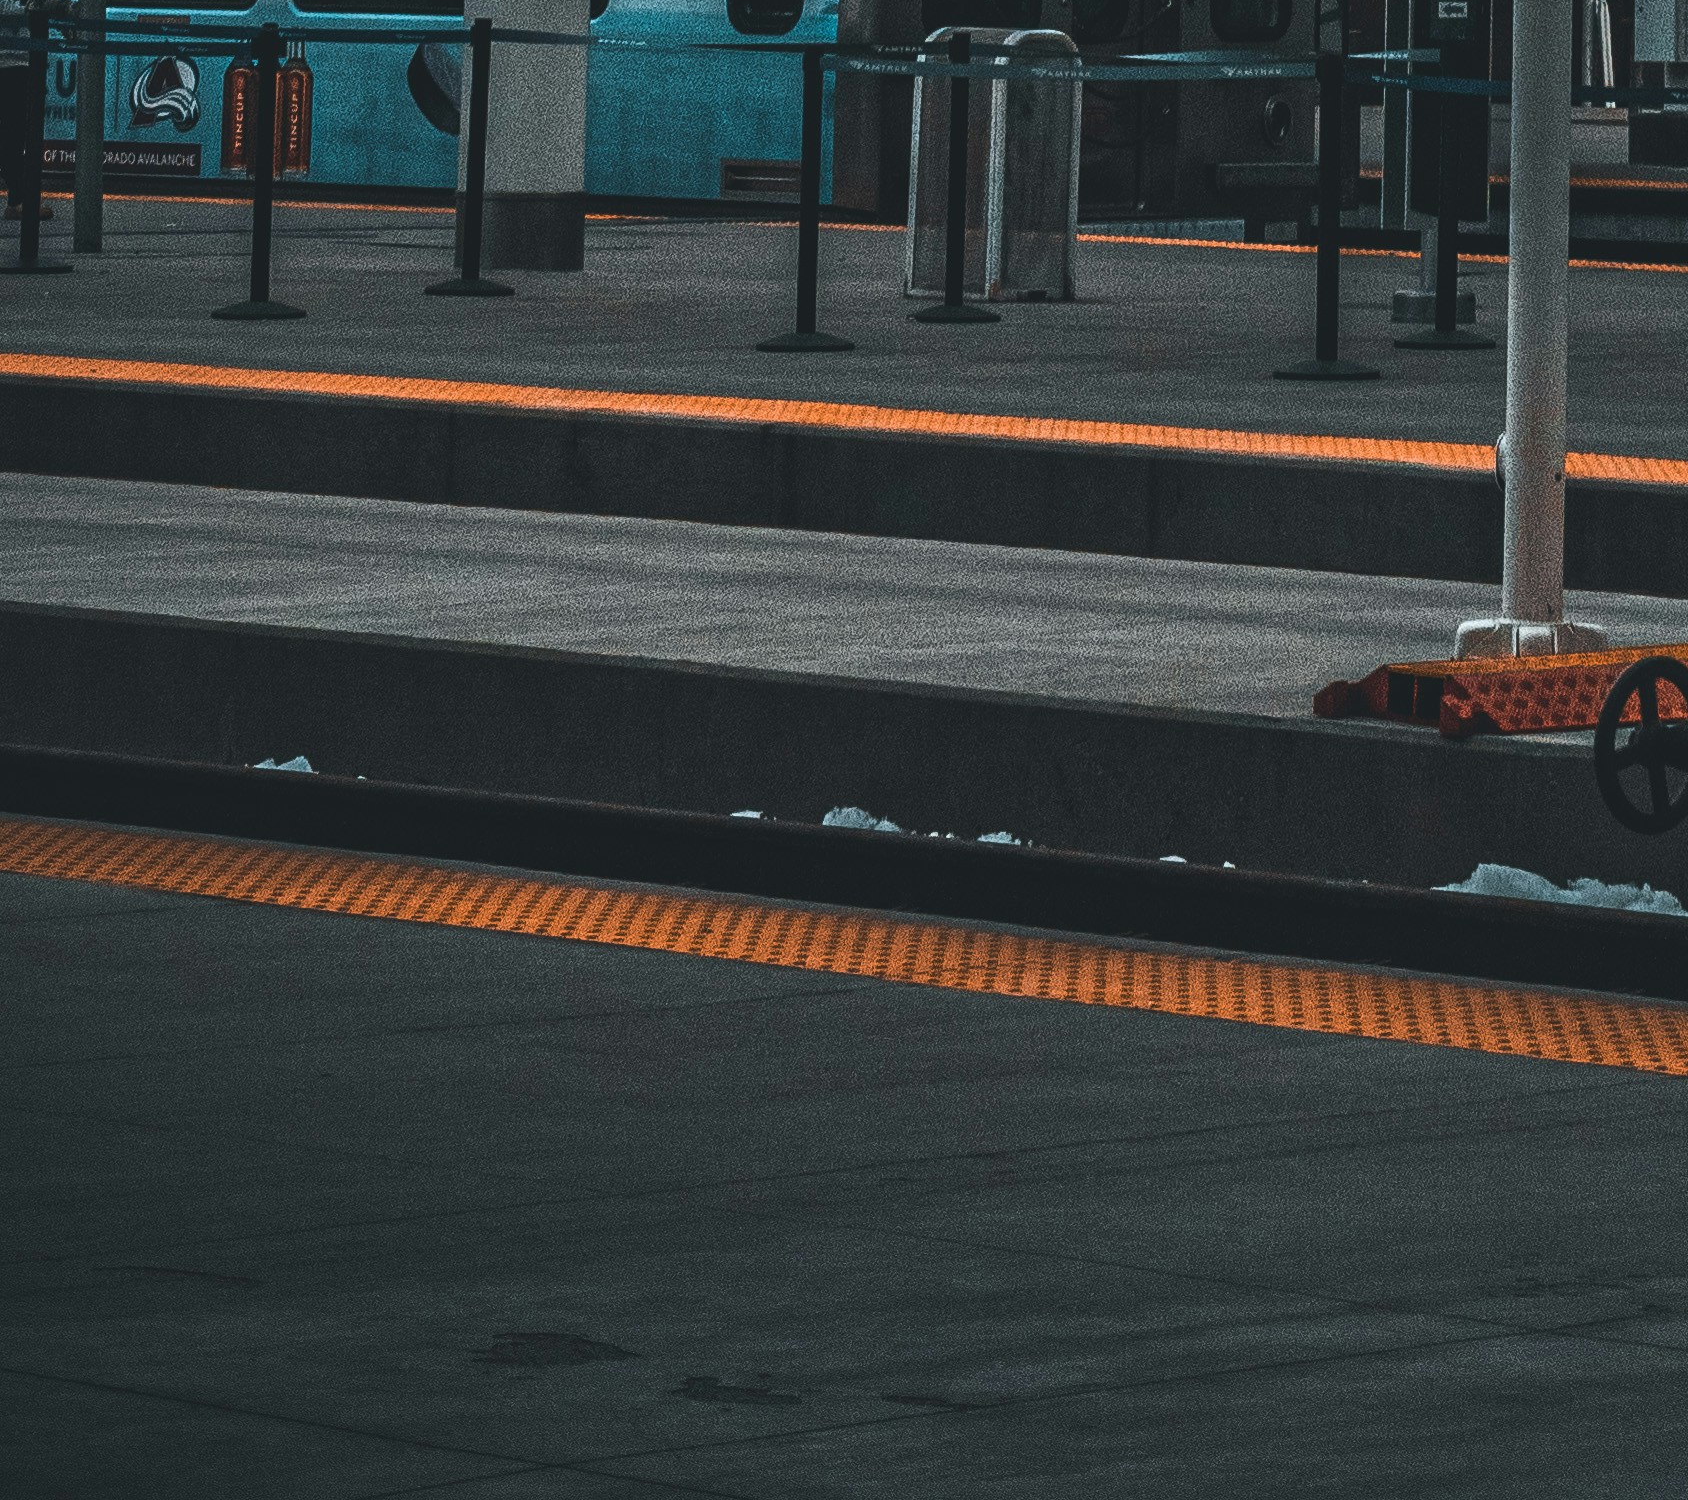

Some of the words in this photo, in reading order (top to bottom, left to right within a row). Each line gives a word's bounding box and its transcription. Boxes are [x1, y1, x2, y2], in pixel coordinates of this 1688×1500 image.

[235, 92, 244, 148] TINCUP
[289, 93, 298, 151] TINCUP
[43, 149, 57, 163] OF
[136, 152, 196, 167] AVALANCHE
